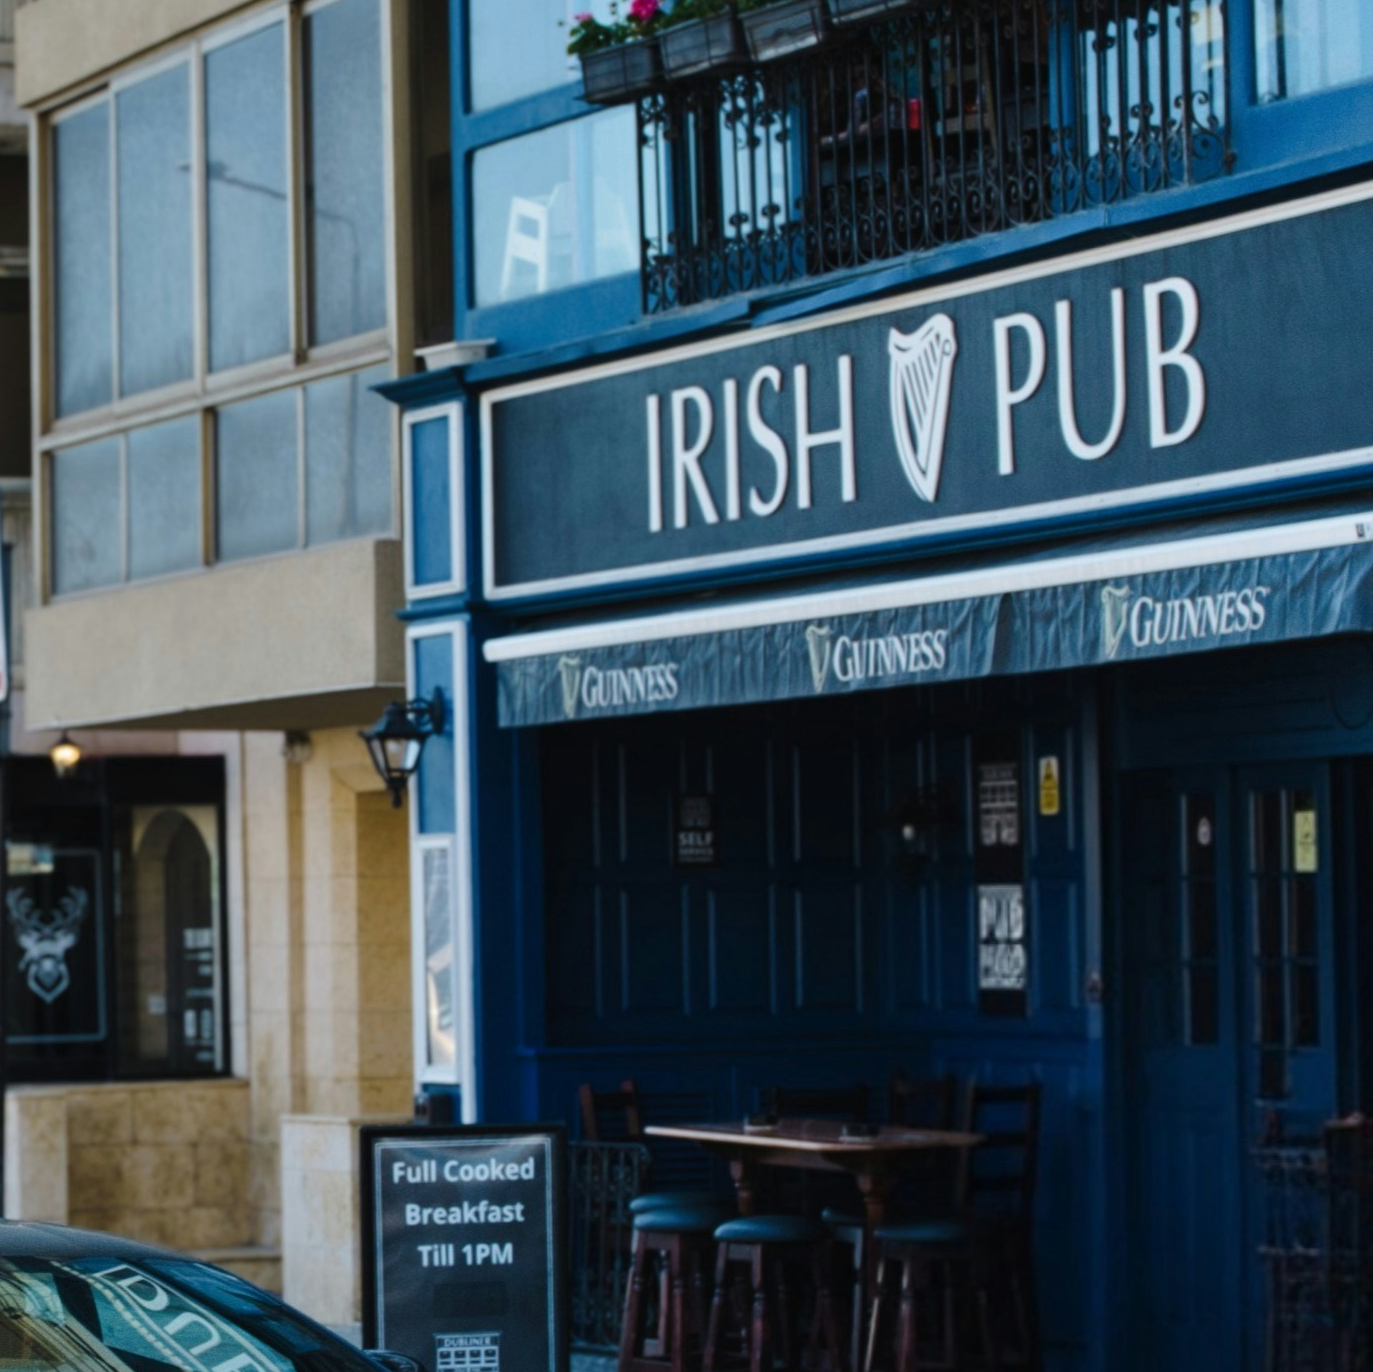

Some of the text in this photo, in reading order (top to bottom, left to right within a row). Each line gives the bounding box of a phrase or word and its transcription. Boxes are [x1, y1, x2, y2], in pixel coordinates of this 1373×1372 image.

[646, 276, 1206, 534] IRISH PUB
[1130, 587, 1266, 647] GUINNESS
[833, 630, 946, 681] GUINNESS
[582, 663, 678, 707] GUINNESS
[393, 1157, 534, 1184] Full Cooked
[405, 1200, 525, 1225] Breakfast
[417, 1243, 513, 1267] Till 1PM
